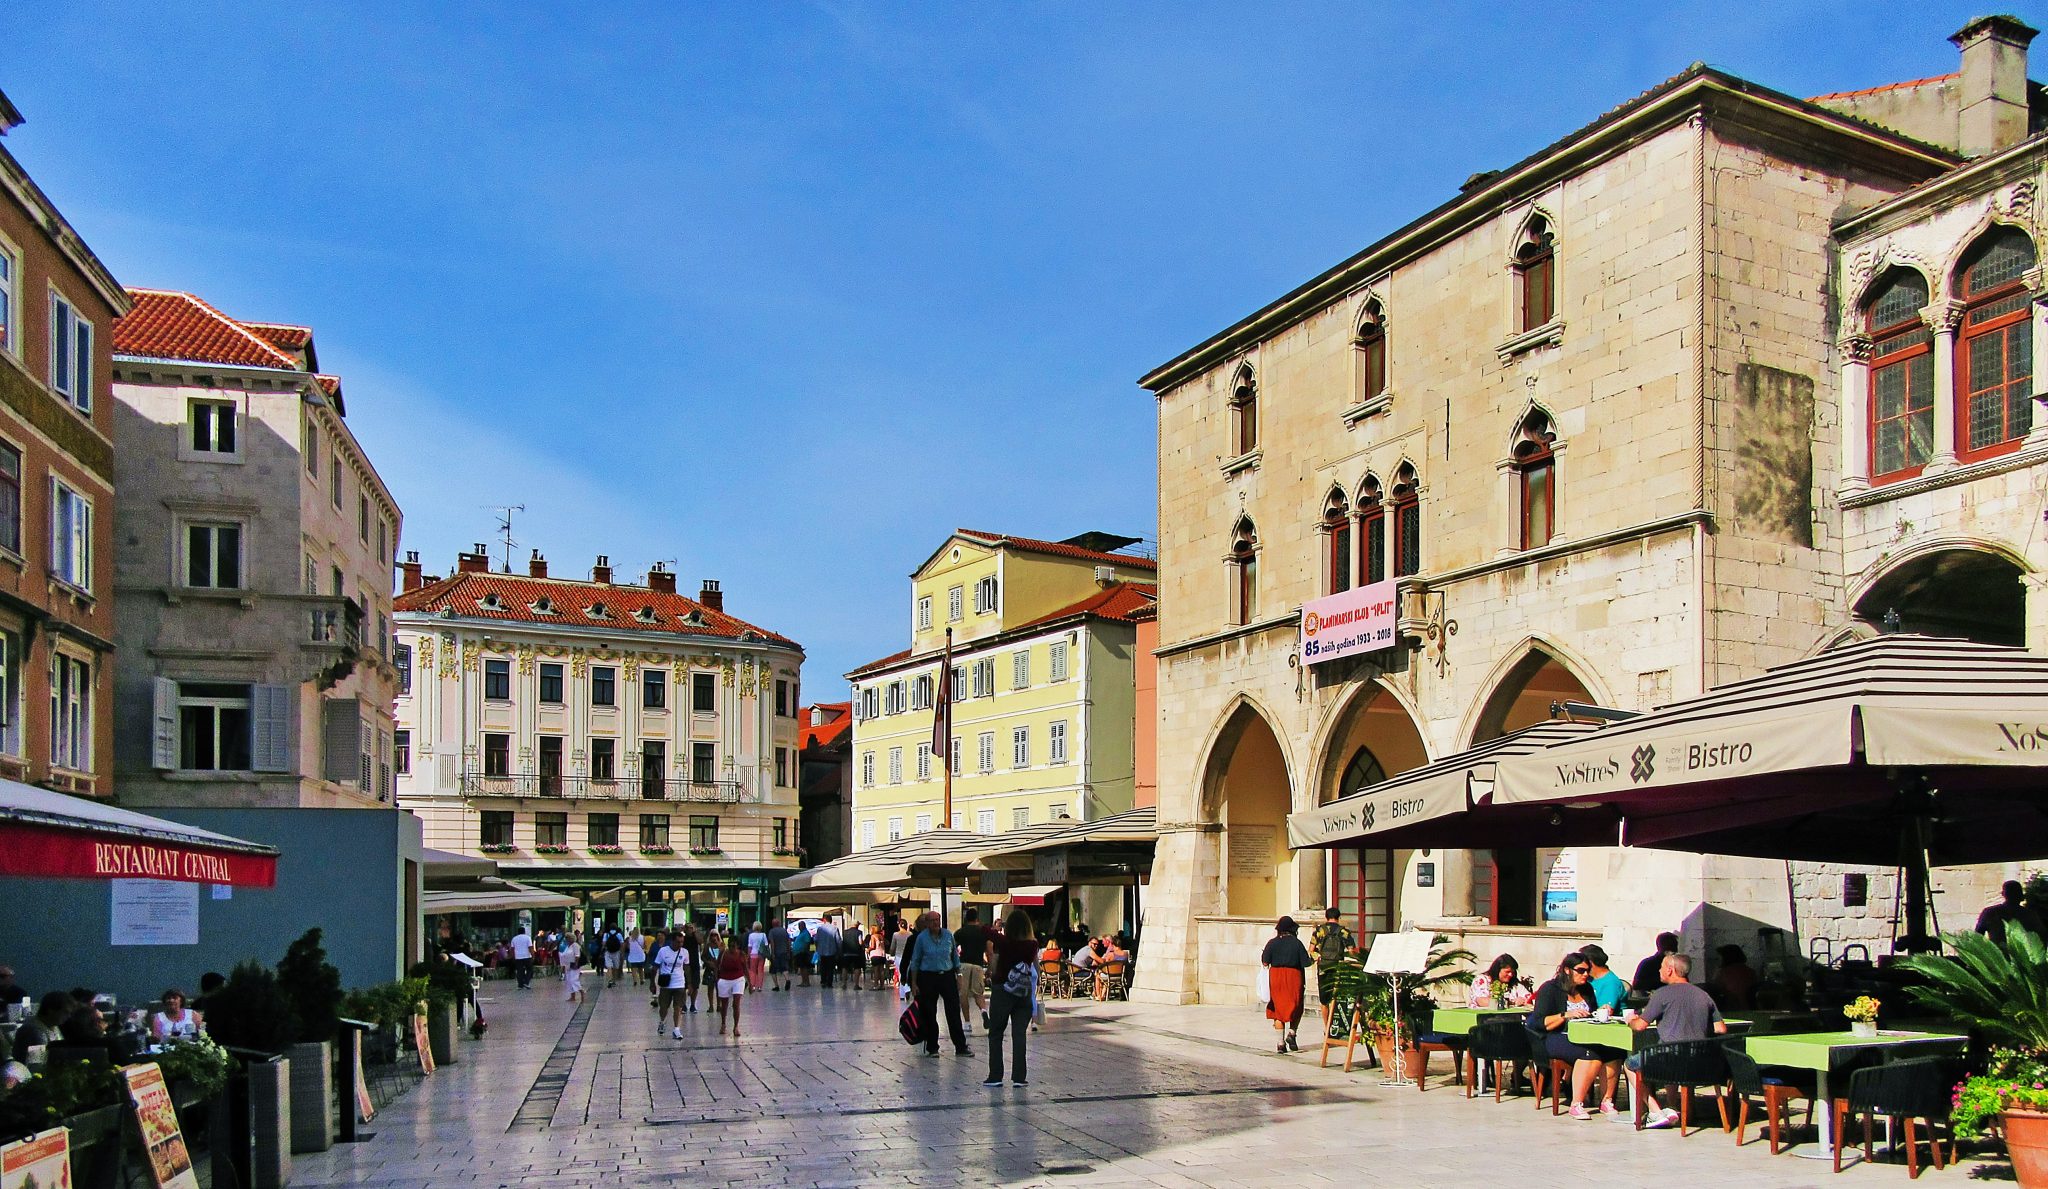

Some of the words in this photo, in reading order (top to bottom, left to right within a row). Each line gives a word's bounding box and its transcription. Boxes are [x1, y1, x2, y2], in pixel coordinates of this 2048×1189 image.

[1319, 608, 1353, 631] PLANINARSKI
[1354, 606, 1370, 623] KLUB
[1304, 639, 1320, 657] 85
[1336, 637, 1356, 654] godina
[1356, 632, 1371, 646] 1933
[1376, 627, 1391, 641] 2018
[1554, 754, 1620, 787] NoStreS
[1688, 742, 1753, 770] Bistro
[1392, 798, 1425, 819] Bistro
[95, 843, 179, 877] RESTAURANT
[184, 852, 231, 881] CENTRAL
